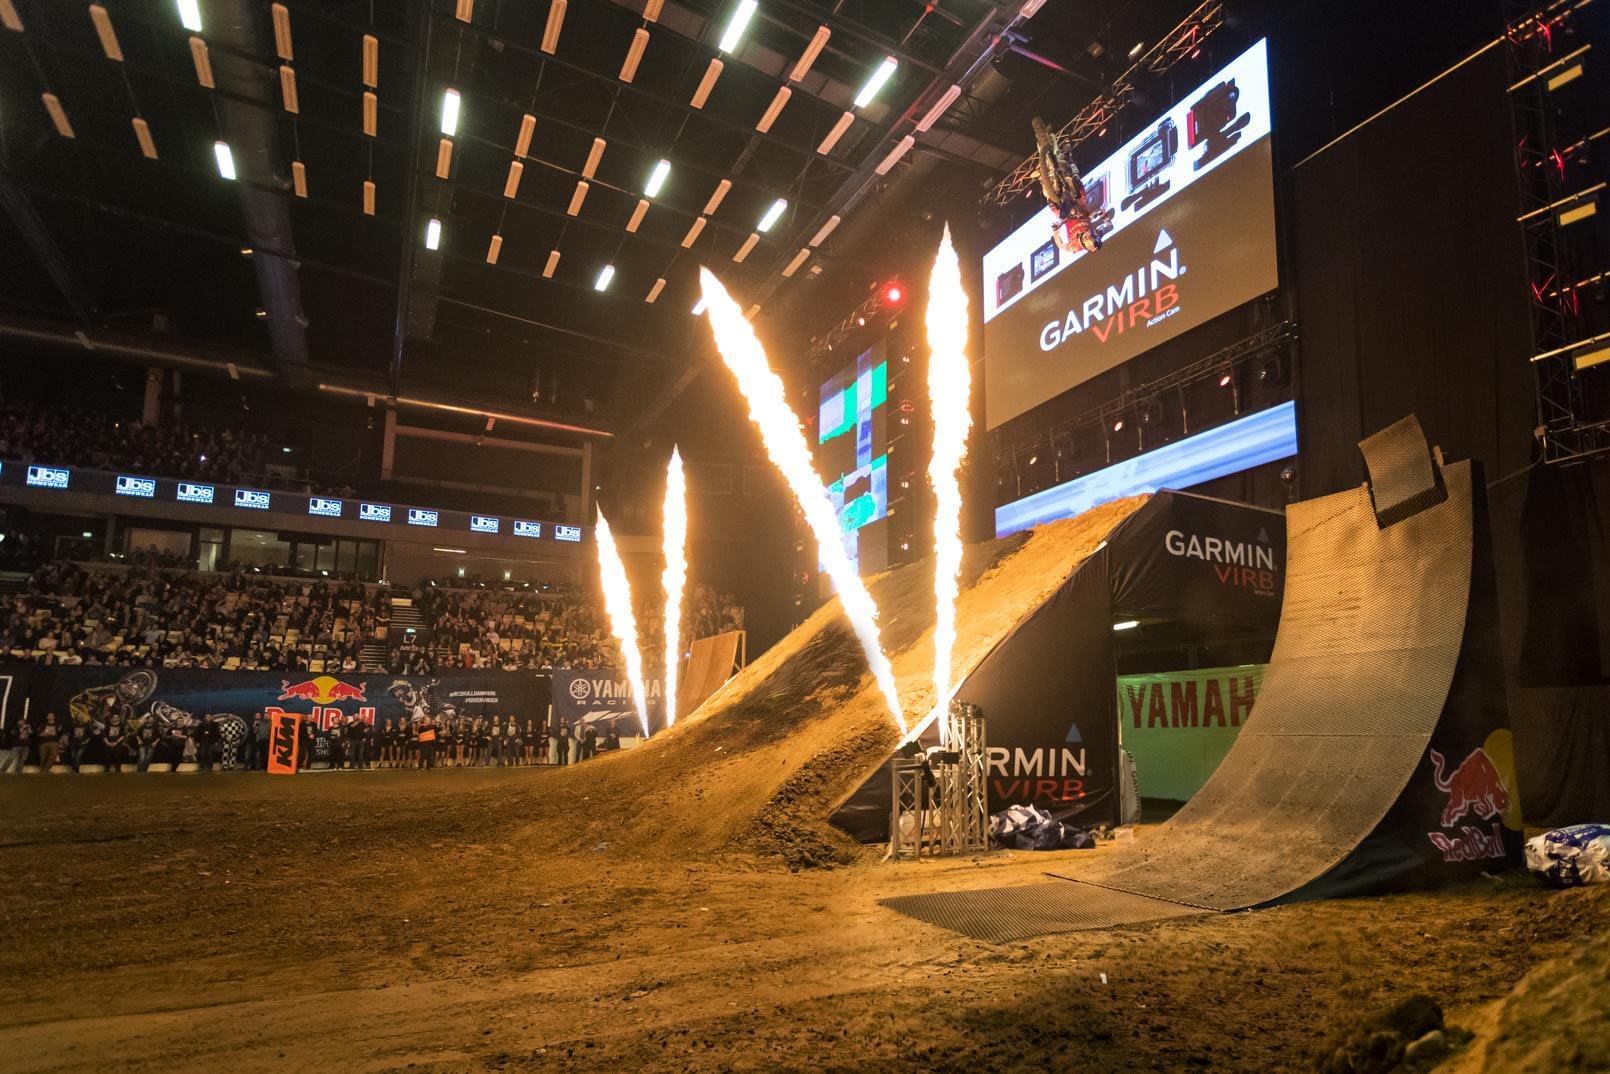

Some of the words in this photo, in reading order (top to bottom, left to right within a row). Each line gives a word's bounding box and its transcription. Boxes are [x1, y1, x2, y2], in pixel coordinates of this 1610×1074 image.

[1039, 248, 1178, 351] GARMIN
[1092, 283, 1179, 343] VIRB
[1146, 313, 1166, 327] Action
[1166, 306, 1180, 317] Cam
[1165, 530, 1273, 570] GARMIN
[1215, 564, 1275, 589] VIRB
[592, 679, 660, 697] YAMA
[1126, 676, 1255, 728] YAMAH
[272, 716, 297, 768] KTM
[985, 747, 1086, 776] RMIN
[993, 779, 1087, 801] VIRB
